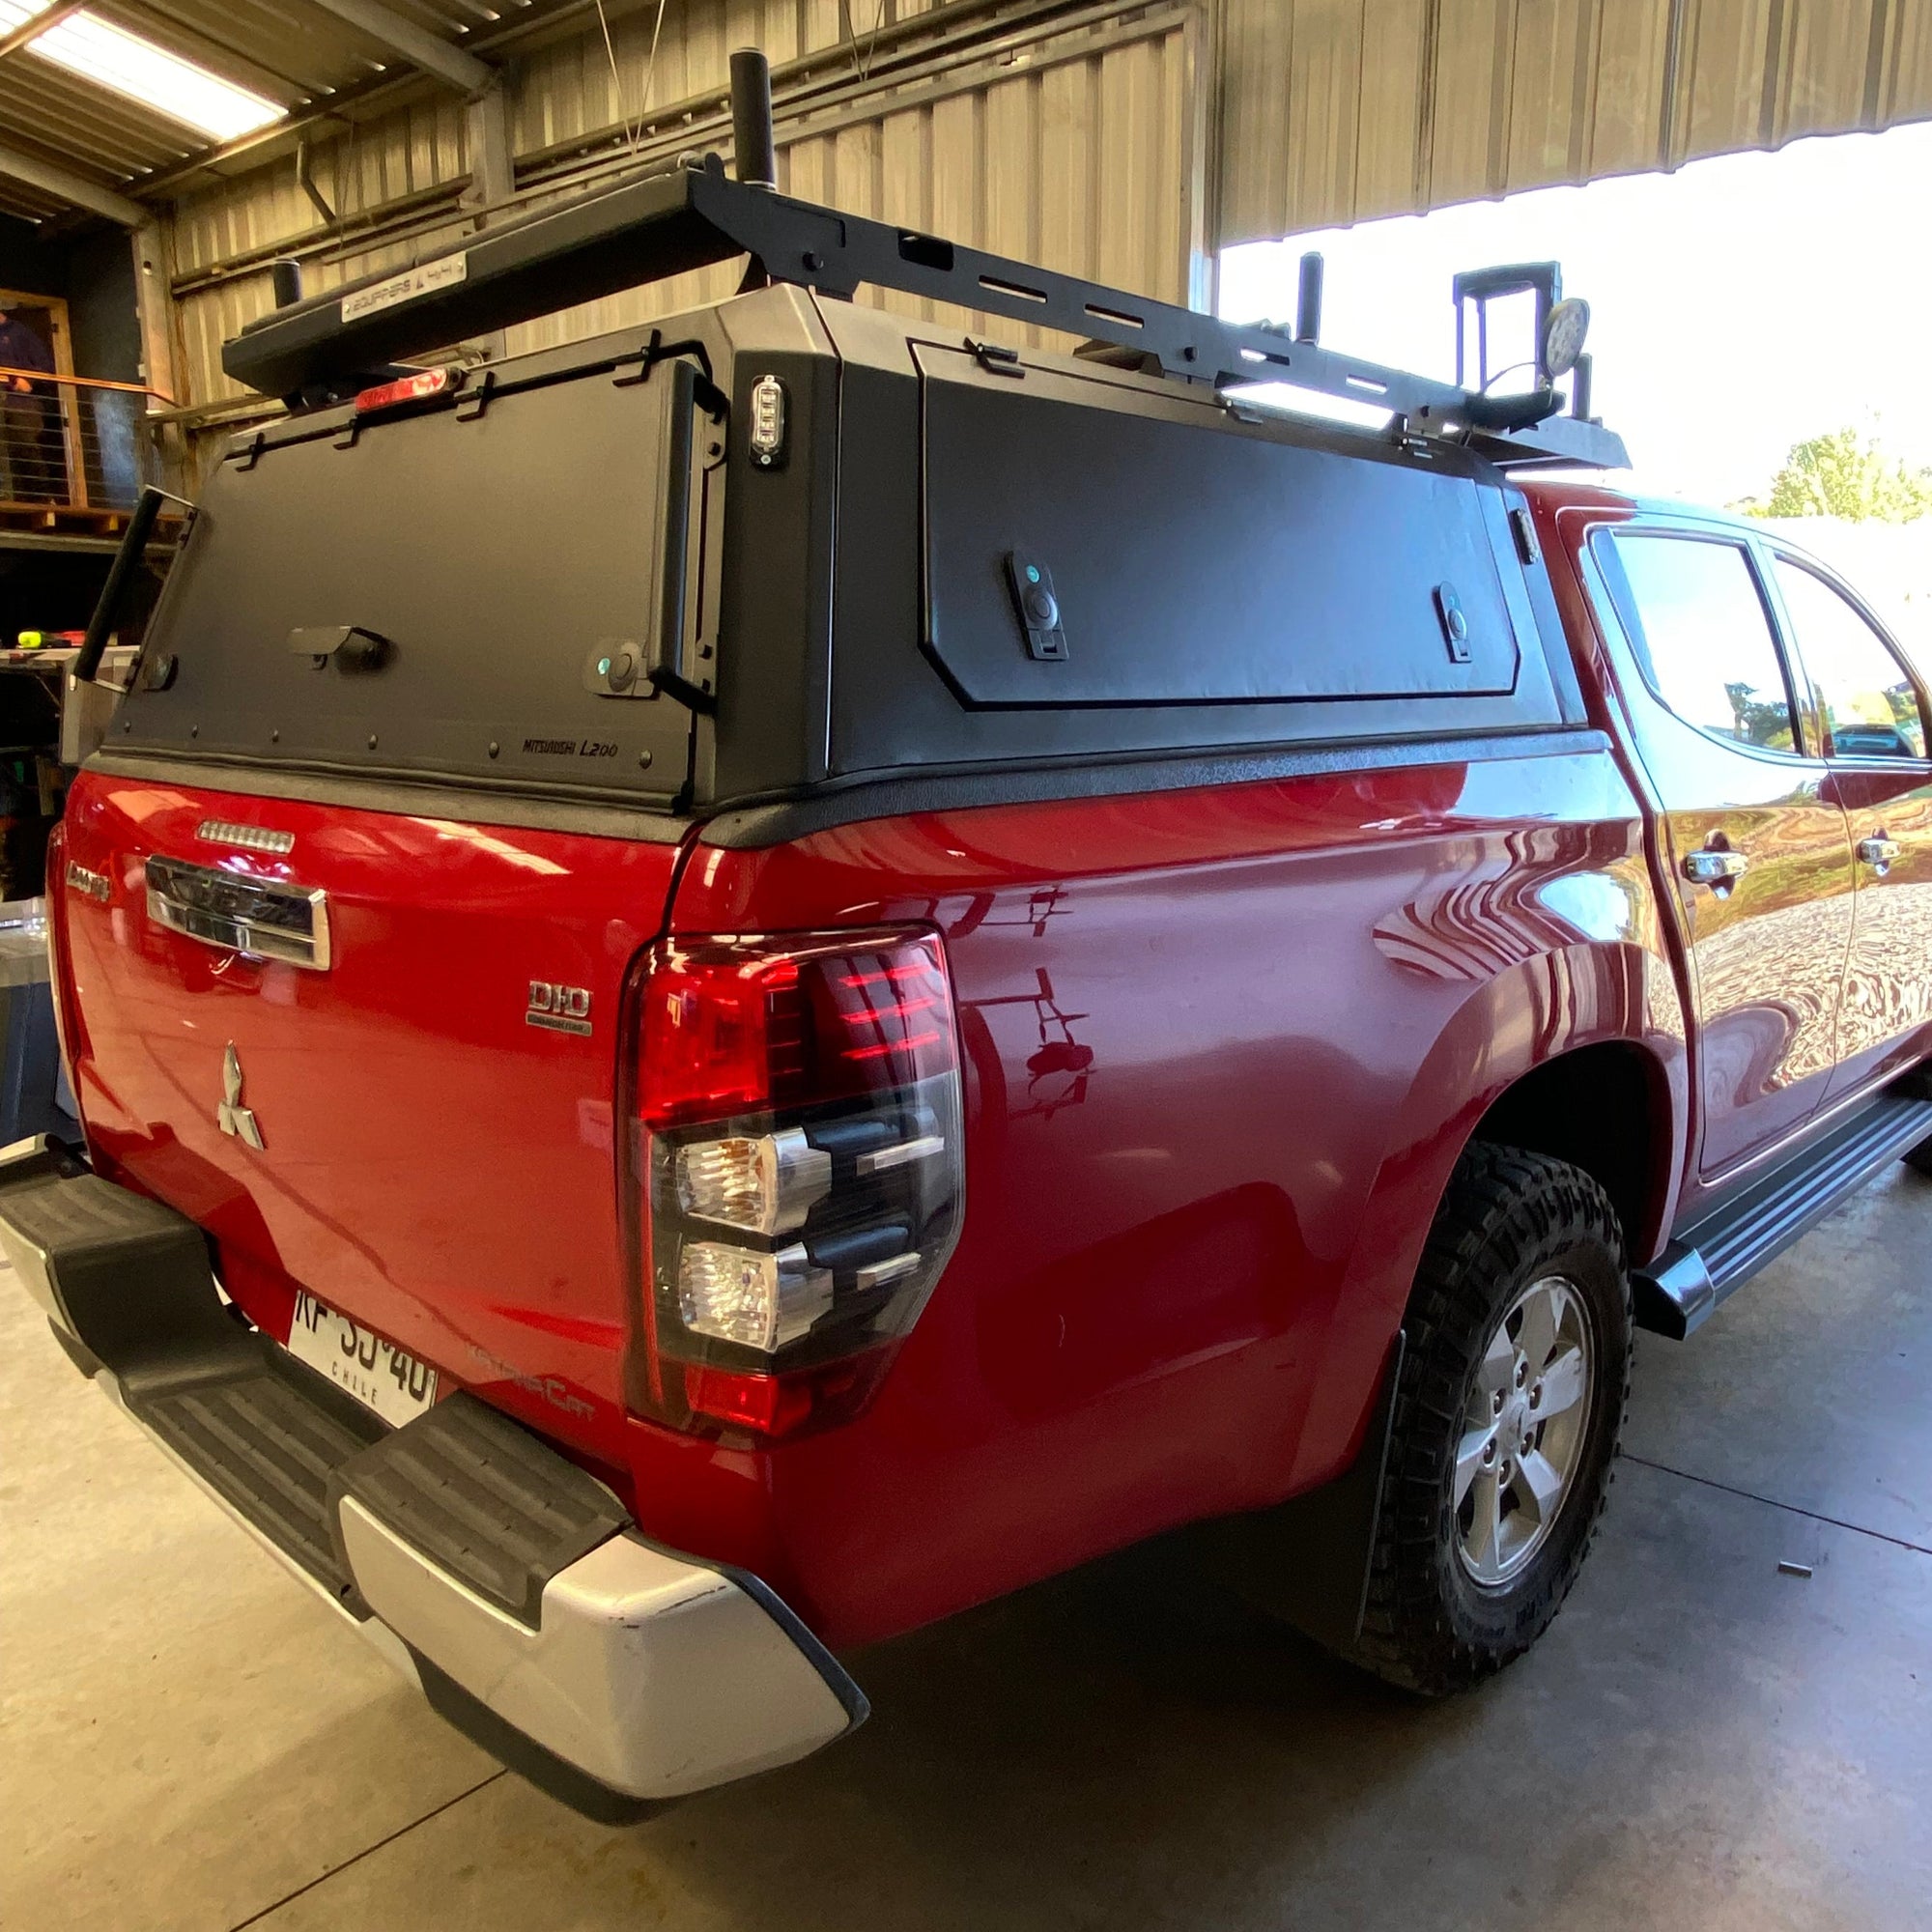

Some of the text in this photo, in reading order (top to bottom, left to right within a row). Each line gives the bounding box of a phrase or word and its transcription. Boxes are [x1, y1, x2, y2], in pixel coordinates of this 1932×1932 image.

[522, 739, 618, 757] MITSUBISHI L200
[331, 1360, 378, 1406] CHILE
